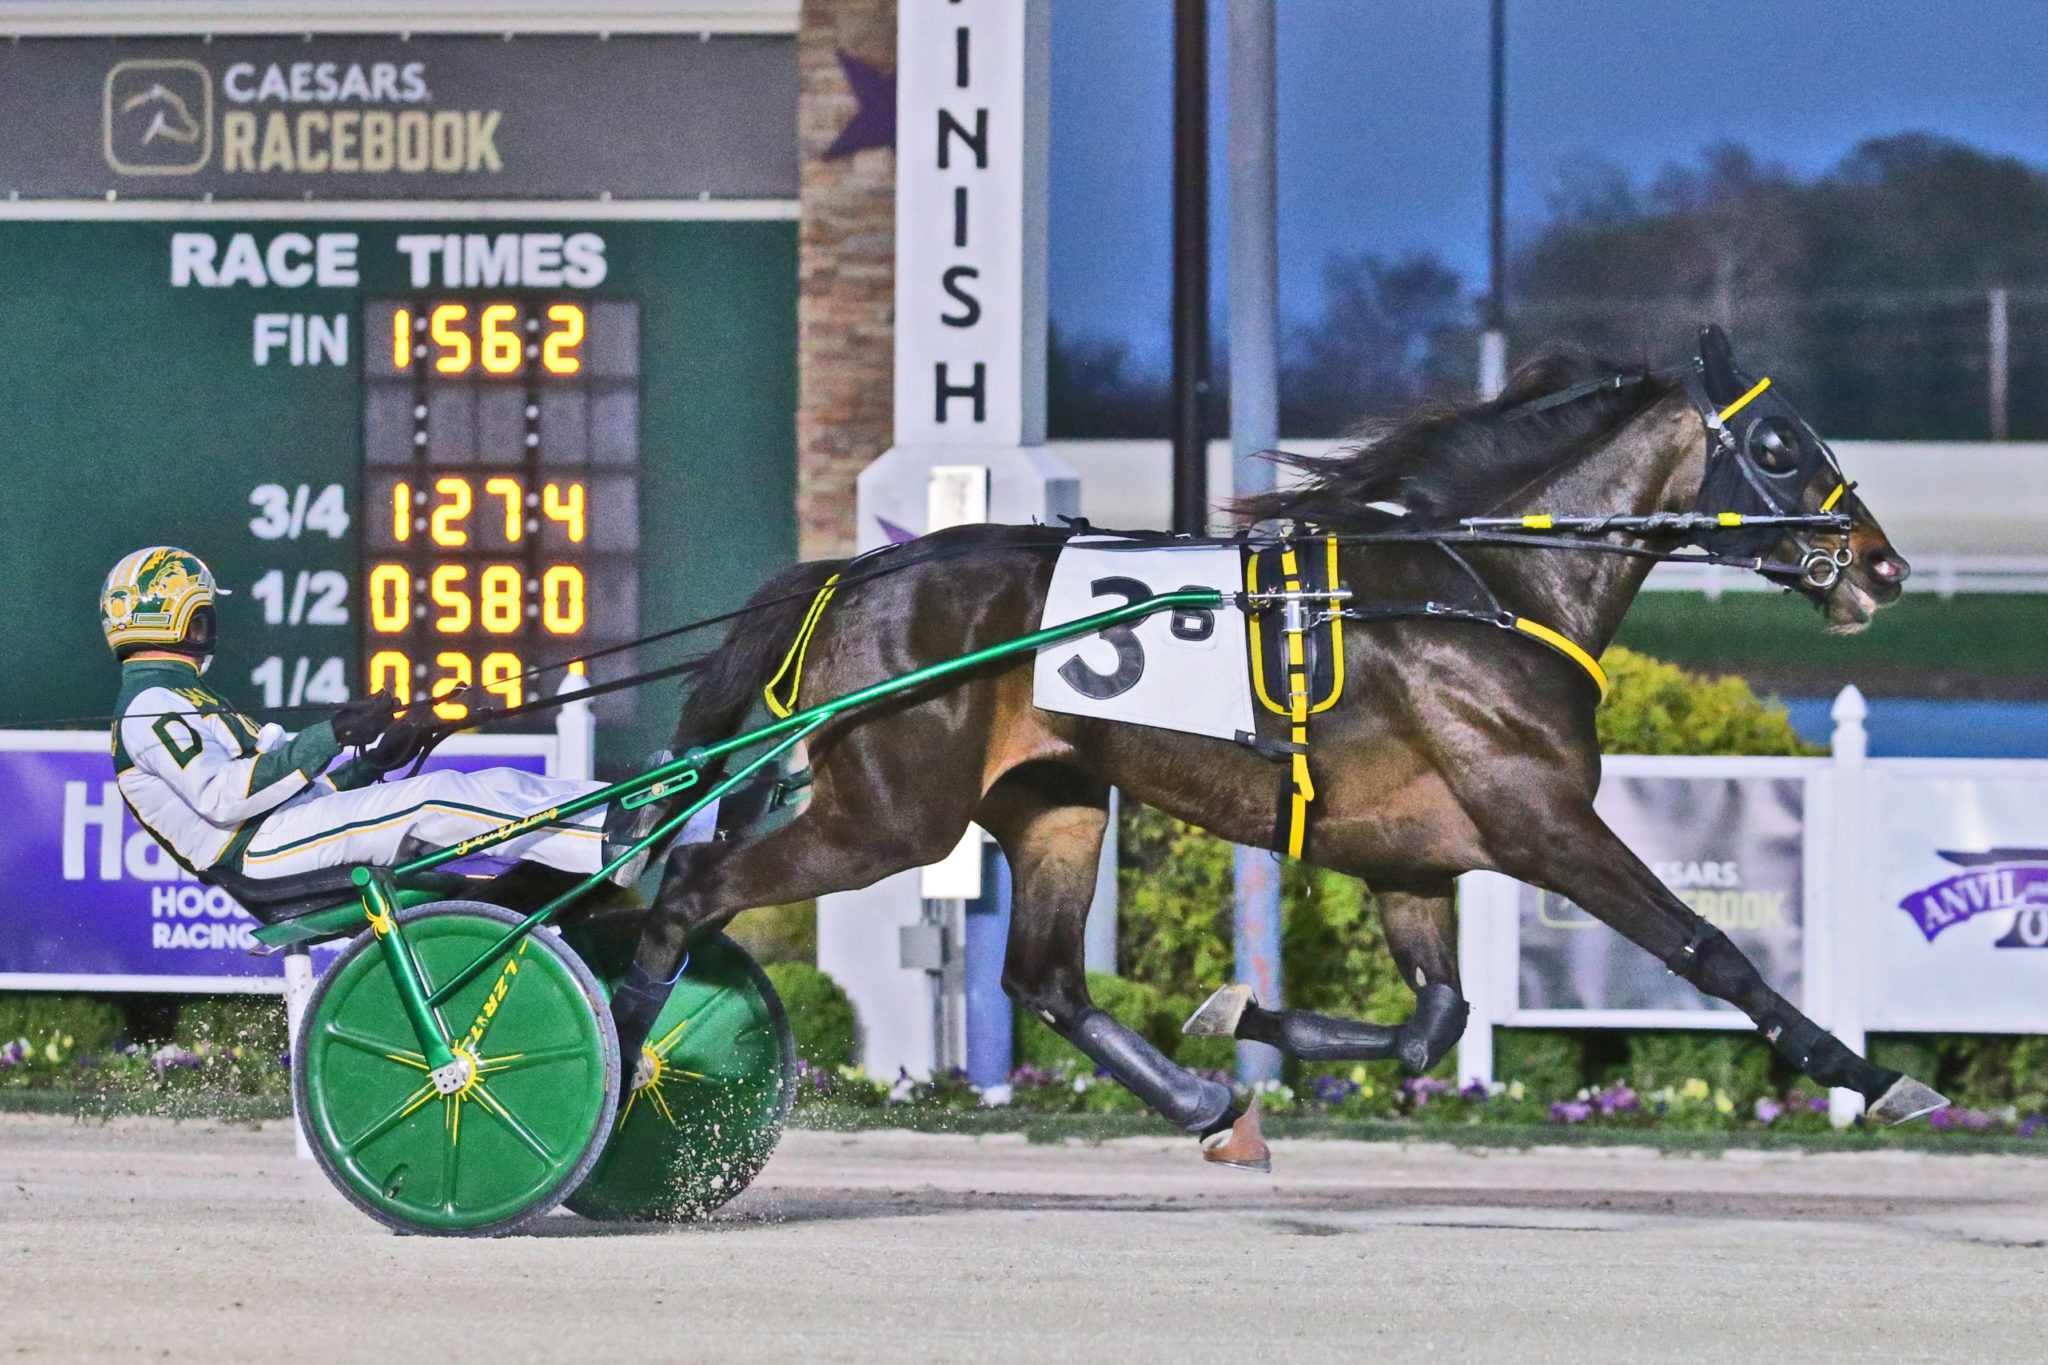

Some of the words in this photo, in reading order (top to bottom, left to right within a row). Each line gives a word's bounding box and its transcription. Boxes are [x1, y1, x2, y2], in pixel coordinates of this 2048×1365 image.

[223, 62, 428, 102] CAESARS
[222, 110, 502, 173] RACEBOOK
[935, 0, 989, 423] INISH
[170, 233, 360, 288] RACE
[396, 233, 608, 288] TIMES
[252, 314, 349, 366] FIN
[249, 483, 349, 540] 3/4
[251, 570, 349, 625] 1/2
[1057, 575, 1154, 700] 3
[251, 656, 349, 709] 1/4
[1923, 869, 2014, 930] ANVIL
